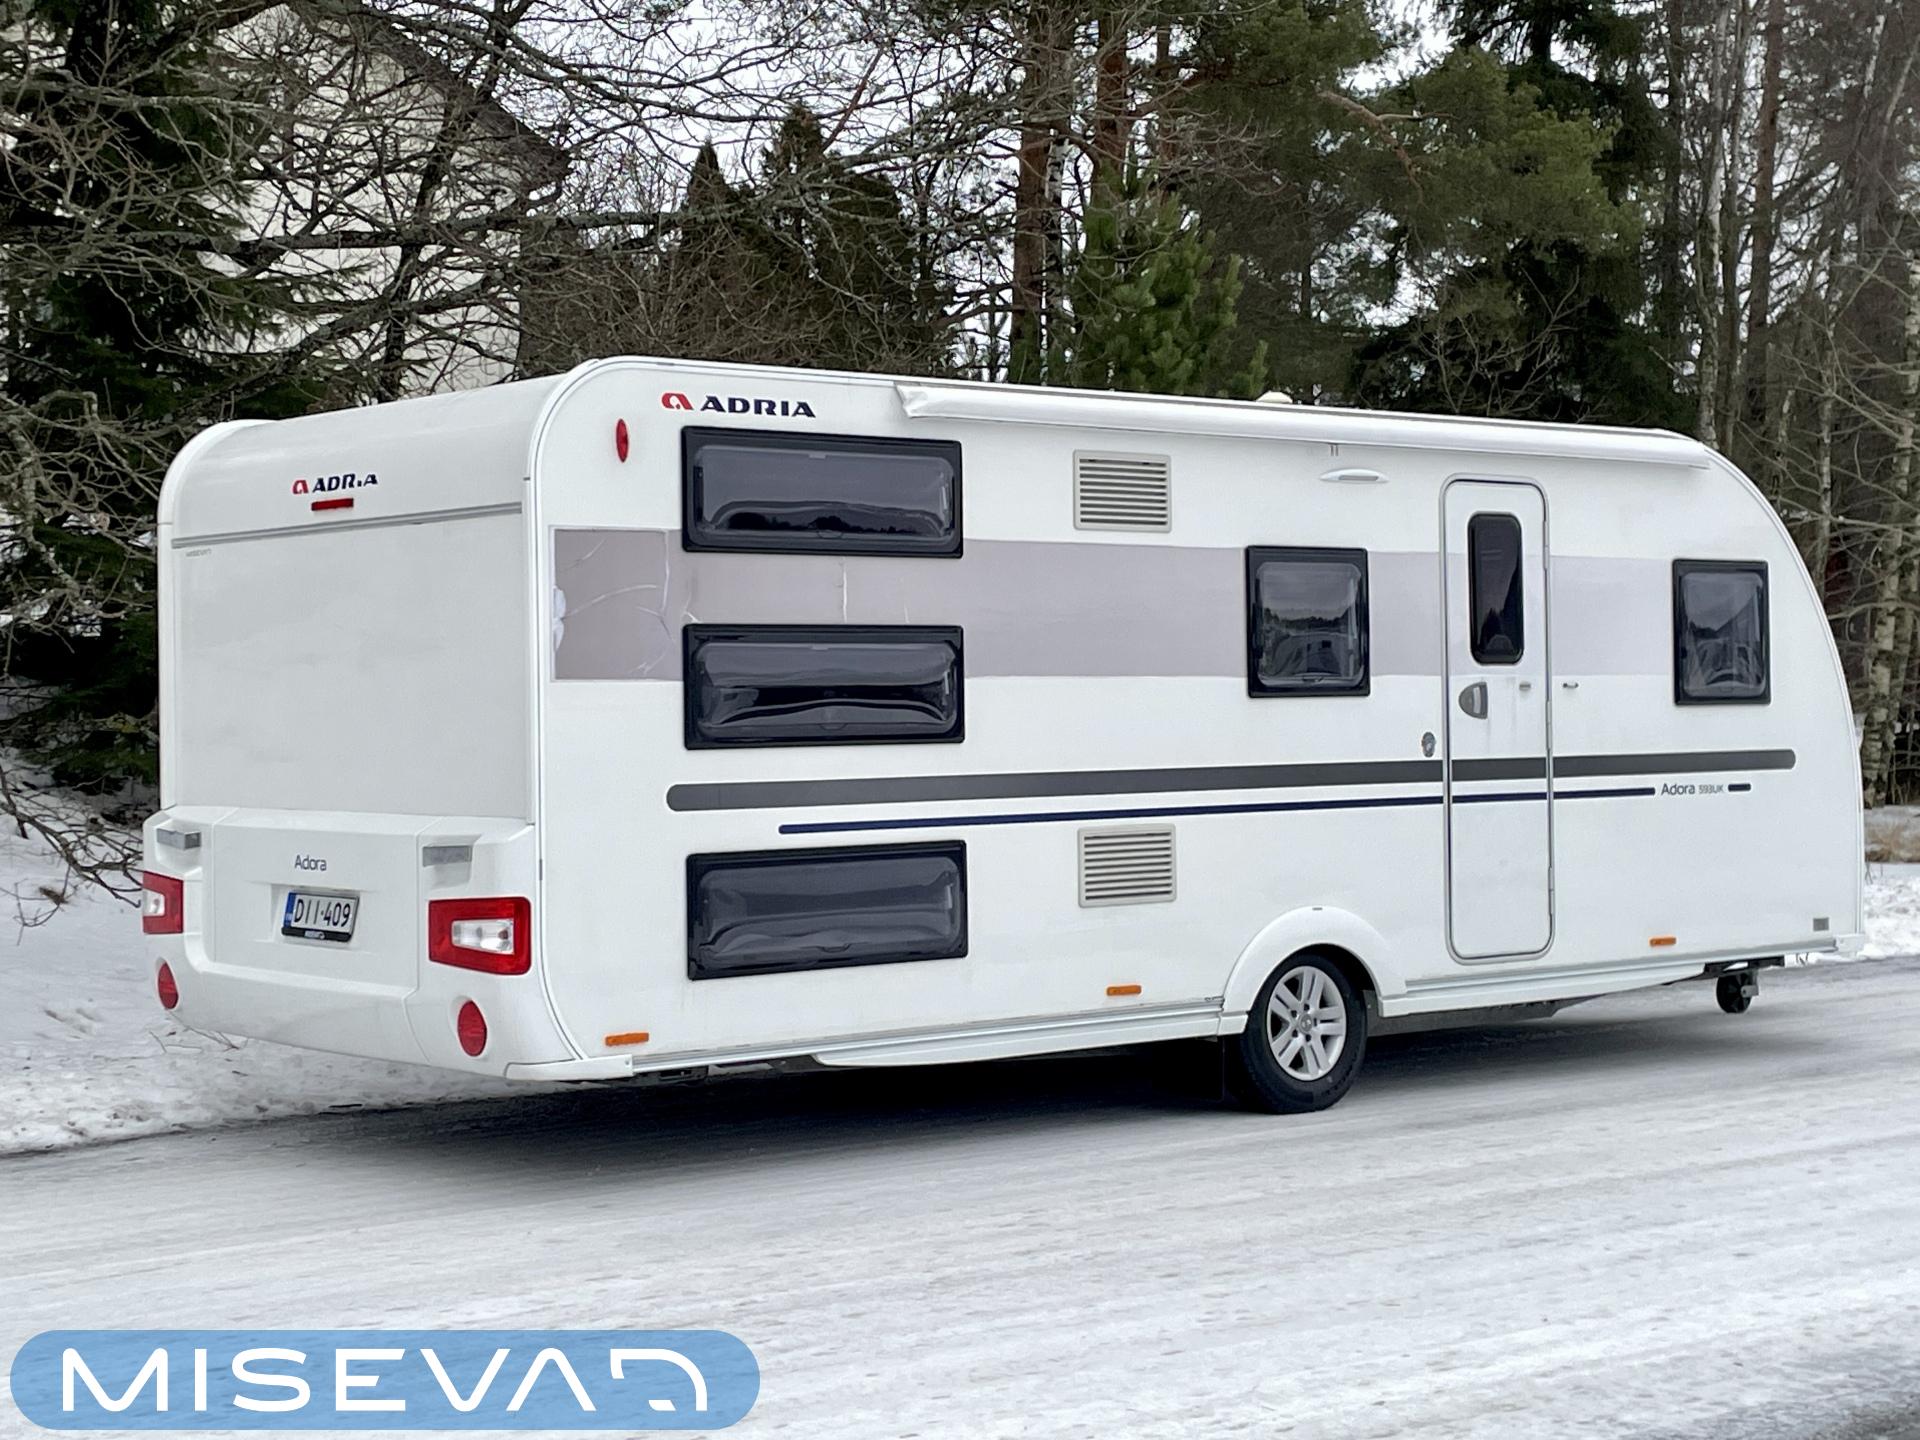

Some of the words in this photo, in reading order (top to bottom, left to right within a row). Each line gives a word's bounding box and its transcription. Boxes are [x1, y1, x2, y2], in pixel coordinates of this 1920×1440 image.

[700, 395, 816, 418] ADRIA
[1661, 783, 1695, 795] Adora
[294, 854, 327, 871] Adora
